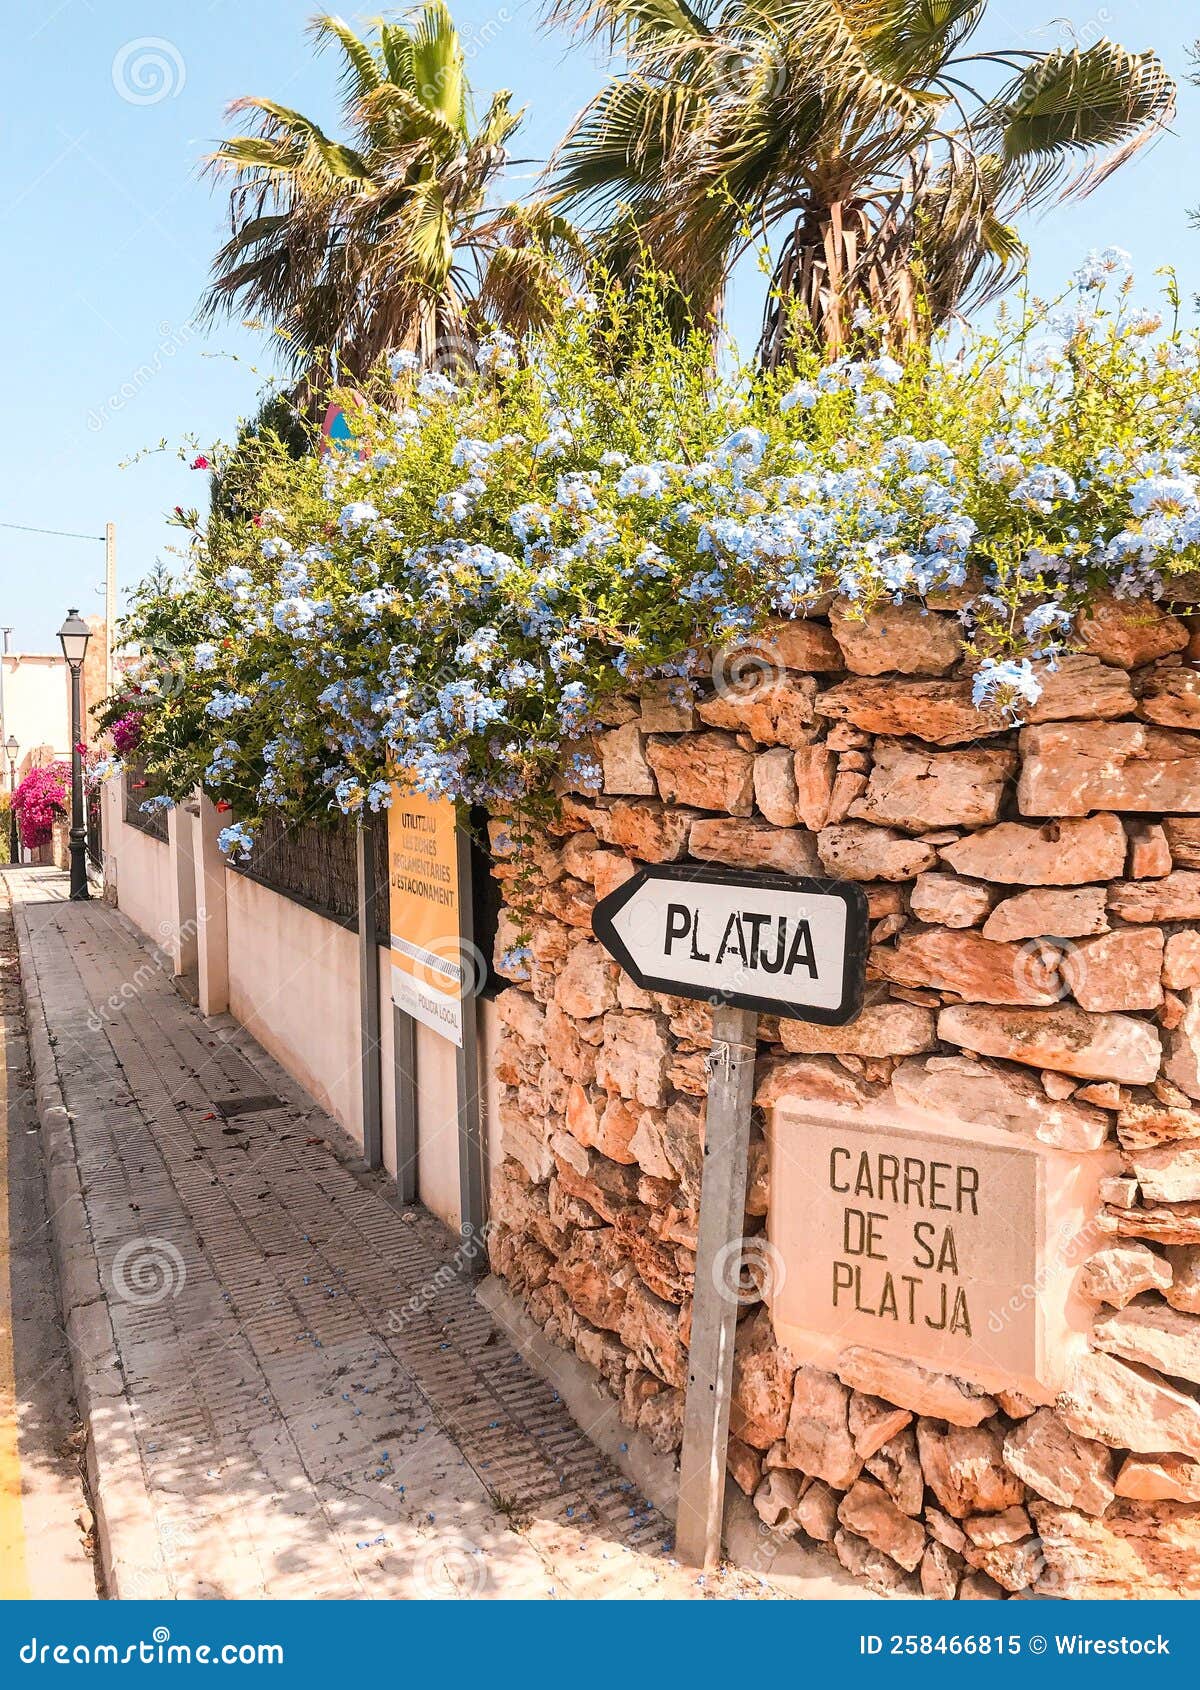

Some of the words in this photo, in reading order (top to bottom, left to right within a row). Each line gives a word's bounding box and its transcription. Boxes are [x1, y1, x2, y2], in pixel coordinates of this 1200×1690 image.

[402, 812, 436, 833] UTILITZAU
[414, 837, 437, 857] ZONES
[391, 872, 454, 907] D'ESTACIONAMENT
[664, 903, 819, 979] PLATJA
[440, 1008, 459, 1028] LOCAL
[830, 1147, 980, 1216] CARRER
[843, 1207, 889, 1261] DE
[913, 1222, 959, 1276] SA
[832, 1261, 972, 1338] PLATJA
